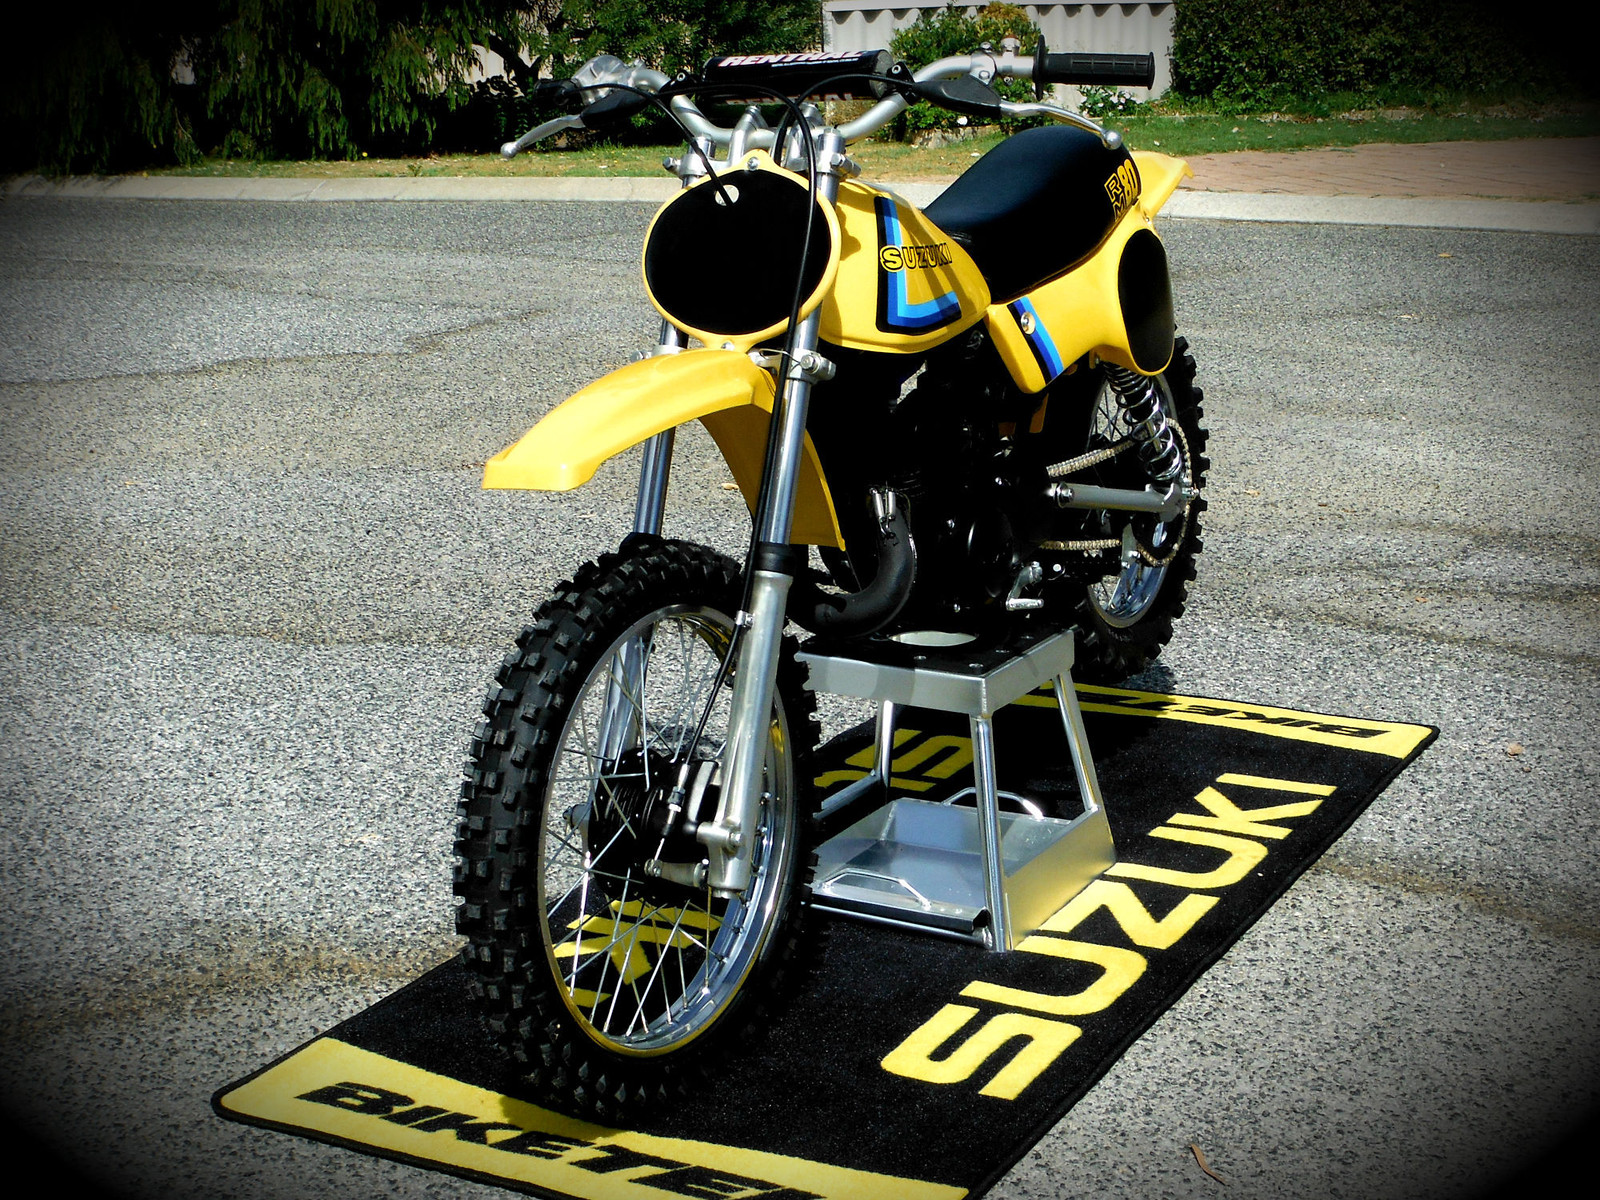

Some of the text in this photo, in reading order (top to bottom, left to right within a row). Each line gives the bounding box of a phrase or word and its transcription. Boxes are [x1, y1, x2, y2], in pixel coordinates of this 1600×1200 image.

[718, 51, 862, 67] RENTHAL
[880, 242, 953, 273] SUZUKI
[881, 772, 1338, 1101] SUZUKI
[294, 1080, 828, 1200] BIKETE
